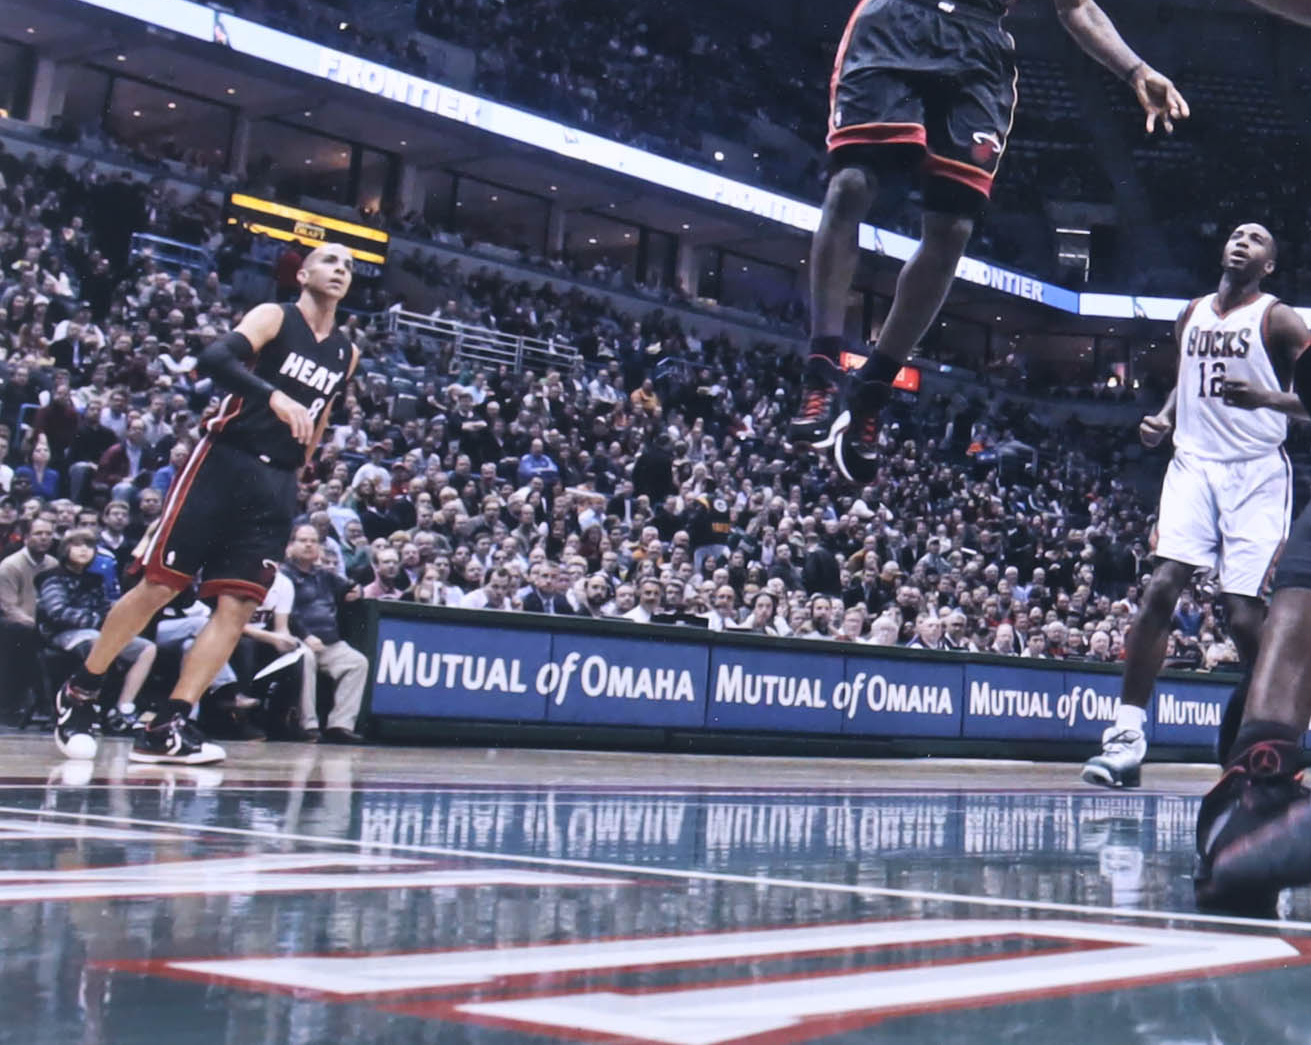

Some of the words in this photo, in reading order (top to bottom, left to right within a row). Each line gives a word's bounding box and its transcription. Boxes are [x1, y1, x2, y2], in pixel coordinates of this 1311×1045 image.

[1187, 326, 1251, 358] BUCKS
[279, 351, 344, 395] HEAT
[1198, 361, 1226, 398] 12
[376, 640, 527, 692] MUTUAL
[536, 652, 581, 705] of
[581, 656, 694, 701] OMAHA
[715, 664, 827, 708] MUTUAL
[832, 673, 867, 719] of
[867, 675, 953, 714] OMAHA
[969, 681, 1053, 718] MUTUAL
[1057, 686, 1081, 727] of
[1082, 688, 1122, 721] OMA
